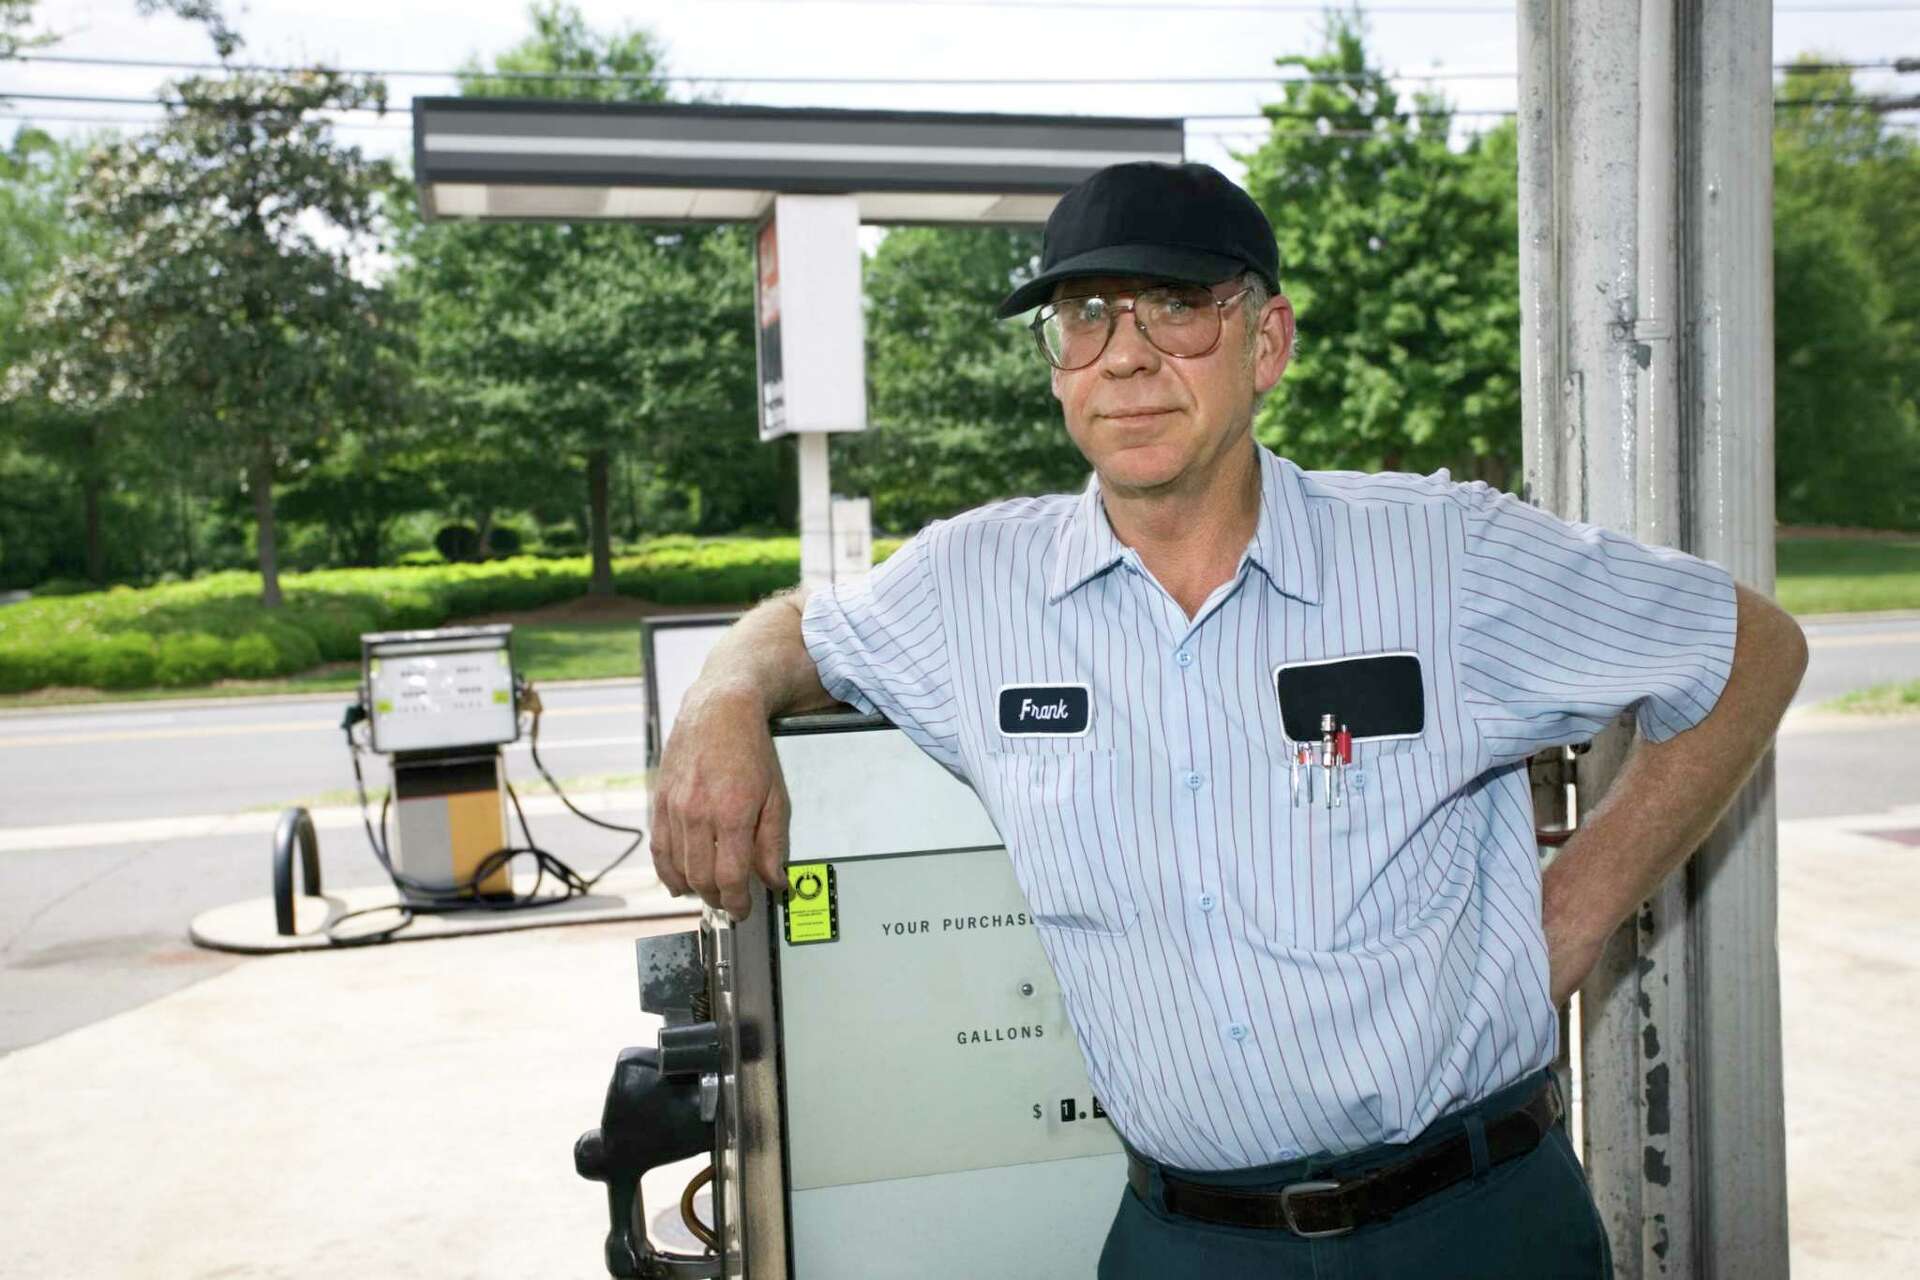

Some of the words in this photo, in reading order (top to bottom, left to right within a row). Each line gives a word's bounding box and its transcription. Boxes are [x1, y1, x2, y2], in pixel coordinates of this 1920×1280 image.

[1018, 697, 1069, 720] Frank
[882, 920, 929, 936] YOUR
[957, 1025, 1045, 1045] GALLONS
